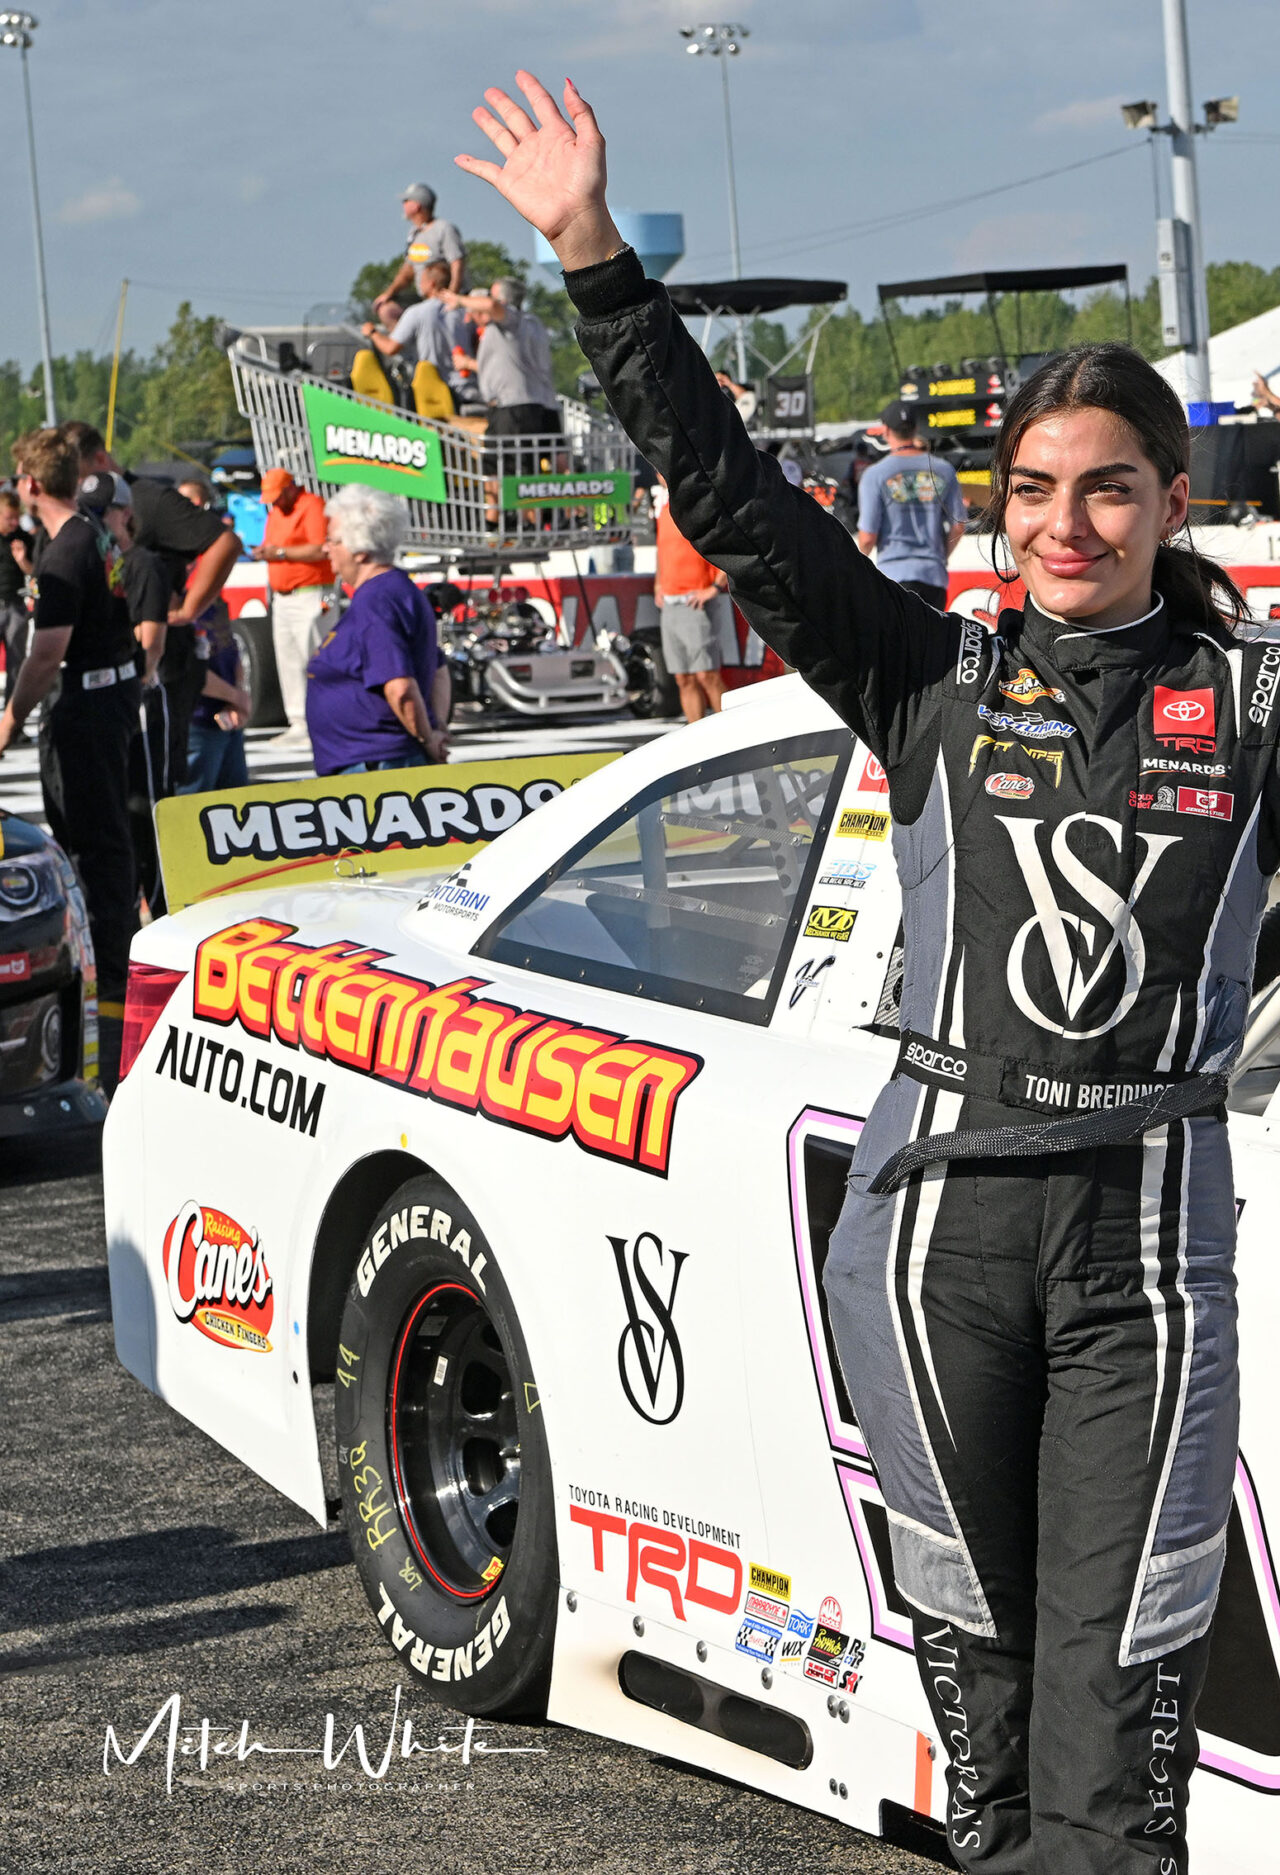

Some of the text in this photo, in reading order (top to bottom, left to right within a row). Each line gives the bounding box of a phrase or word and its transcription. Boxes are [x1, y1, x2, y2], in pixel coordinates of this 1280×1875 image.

[775, 391, 806, 418] 30
[325, 424, 428, 468] MENARDS
[518, 480, 616, 498] MENARDS
[959, 620, 983, 684] sparco
[1155, 737, 1216, 754] TRD
[1142, 758, 1226, 775] MENARDS
[840, 813, 888, 832] CHAMPION
[904, 1041, 968, 1078] sparco
[155, 1025, 326, 1138] AUTO.COM
[1025, 1073, 1071, 1108] TONI
[204, 1212, 241, 1249] Raising
[167, 1199, 273, 1321] Cane's
[357, 1205, 488, 1297] GENERAL
[568, 1485, 741, 1550] TOYOTA RACING DEVELOPMENT
[570, 1504, 743, 1622] TRD
[751, 1567, 789, 1592] CHAMPION
[376, 1582, 511, 1682] GENERAL
[789, 1616, 809, 1635] TORK
[781, 1640, 807, 1657] WIX
[1144, 1662, 1181, 1836] SECRET
